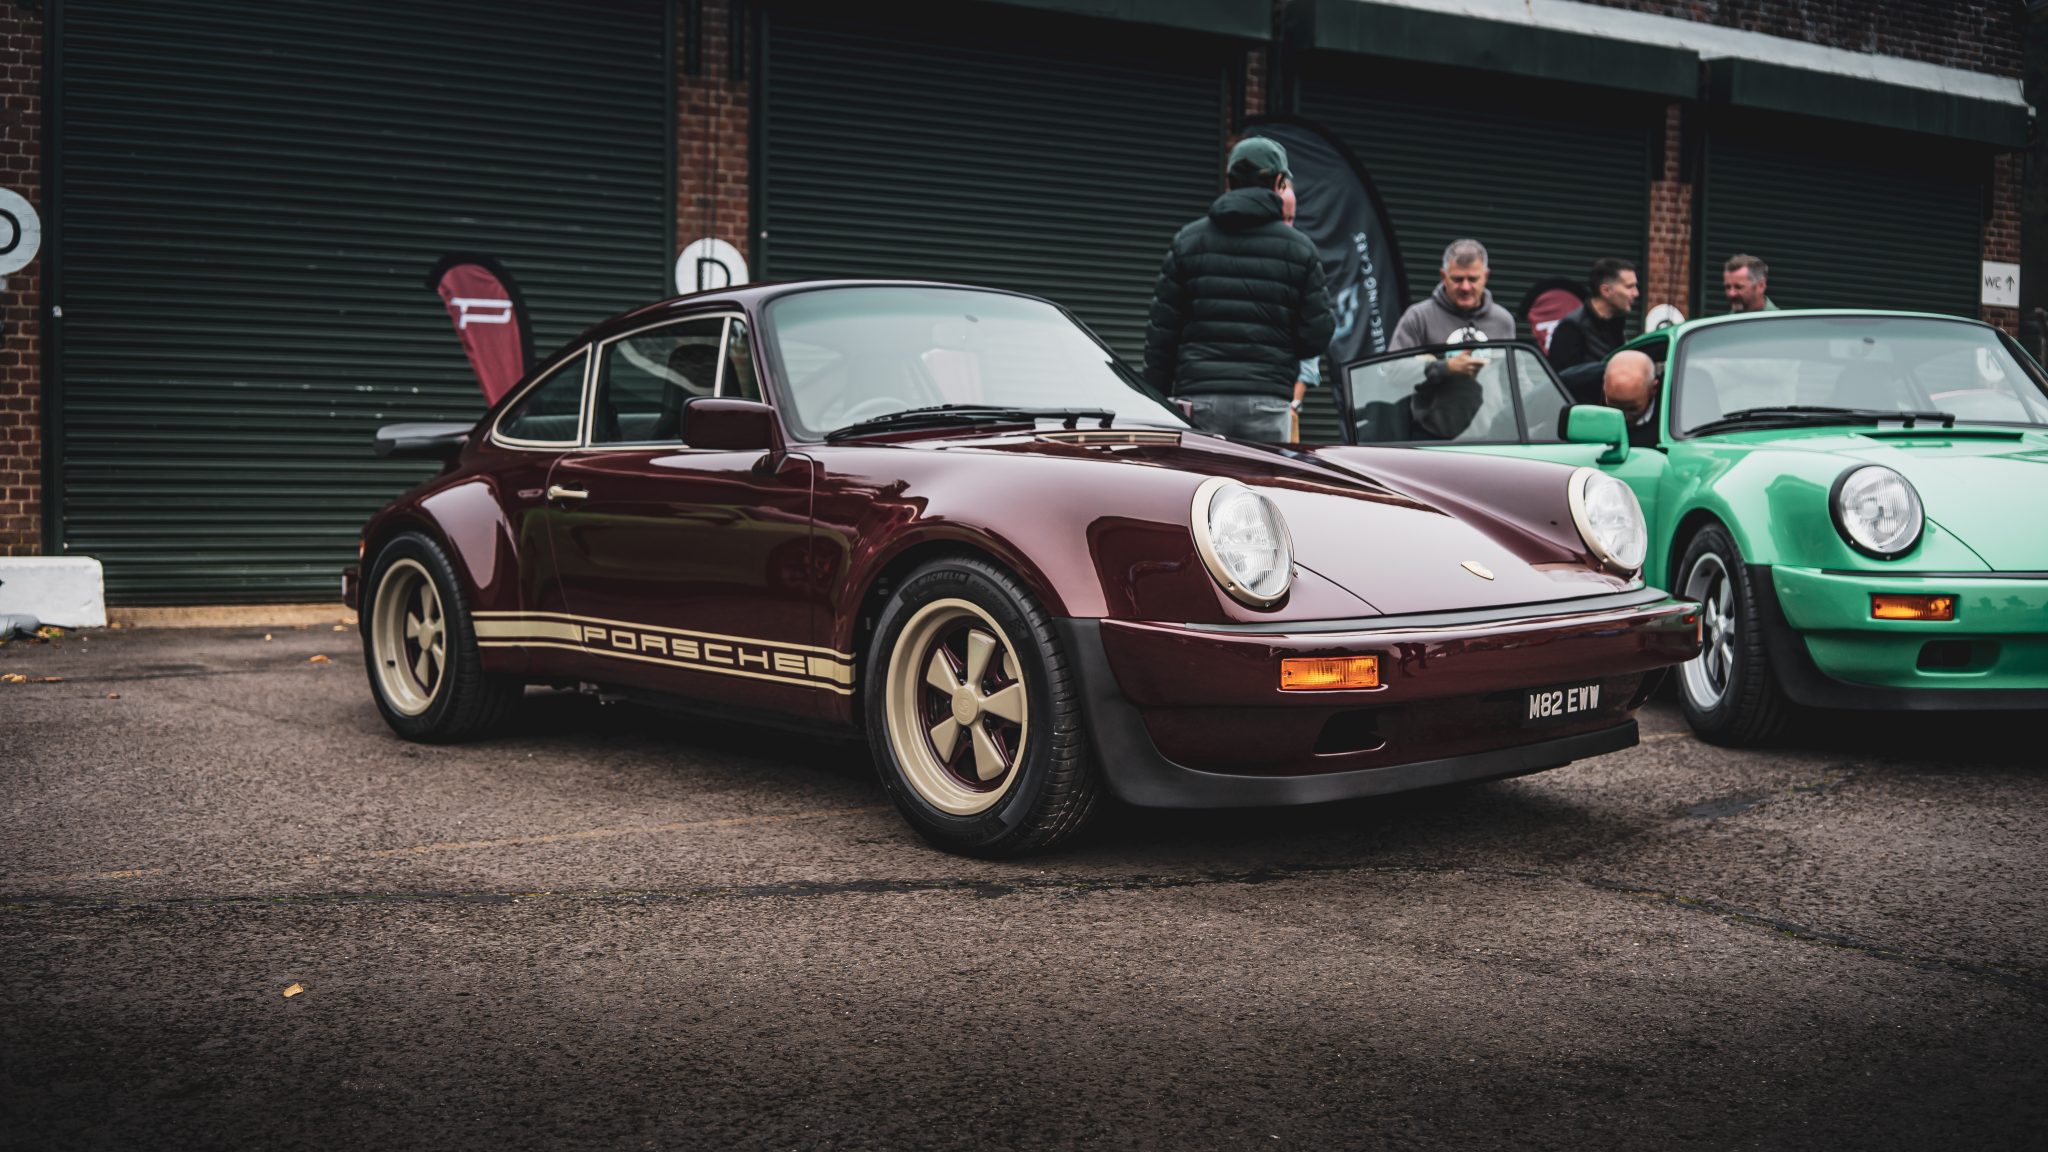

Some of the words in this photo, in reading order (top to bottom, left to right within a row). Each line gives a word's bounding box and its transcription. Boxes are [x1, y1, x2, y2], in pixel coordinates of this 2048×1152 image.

[1353, 232, 1373, 275] CARS
[1985, 274, 2002, 291] WC
[1362, 276, 1386, 353] LLECTING
[917, 570, 968, 587] MICHELIN
[583, 625, 806, 674] PORSCHE
[1529, 690, 1563, 720] M82
[1567, 684, 1600, 713] EWW
